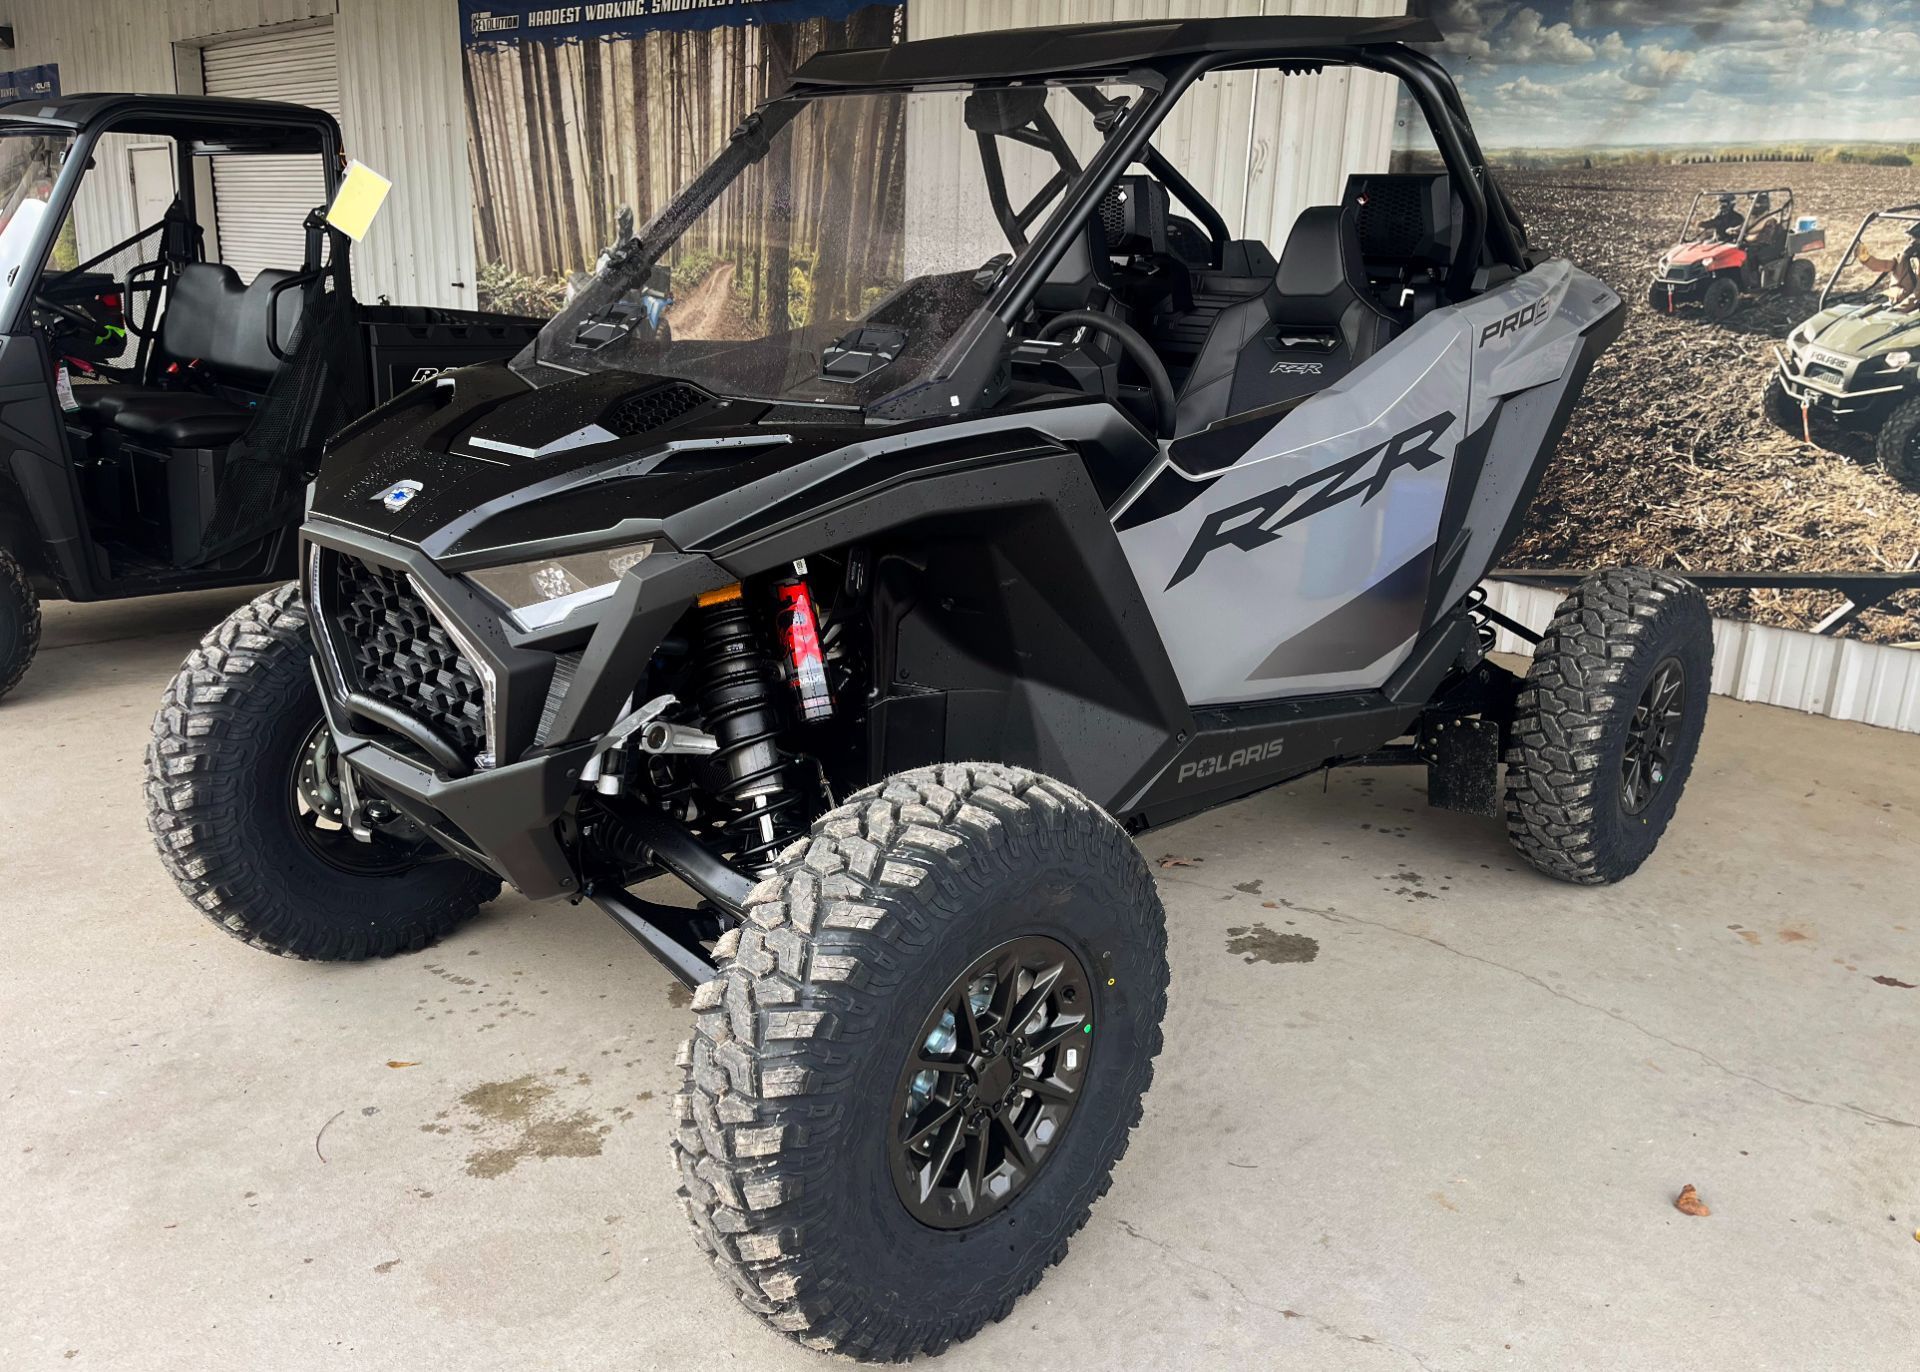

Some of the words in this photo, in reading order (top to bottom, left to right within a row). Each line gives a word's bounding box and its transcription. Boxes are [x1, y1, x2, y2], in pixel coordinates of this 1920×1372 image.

[528, 6, 581, 27] HARDEST
[585, 0, 648, 21] WORKING.
[1268, 361, 1324, 374] RZR
[1163, 410, 1456, 593] RZR
[1177, 738, 1285, 783] POLARIS
